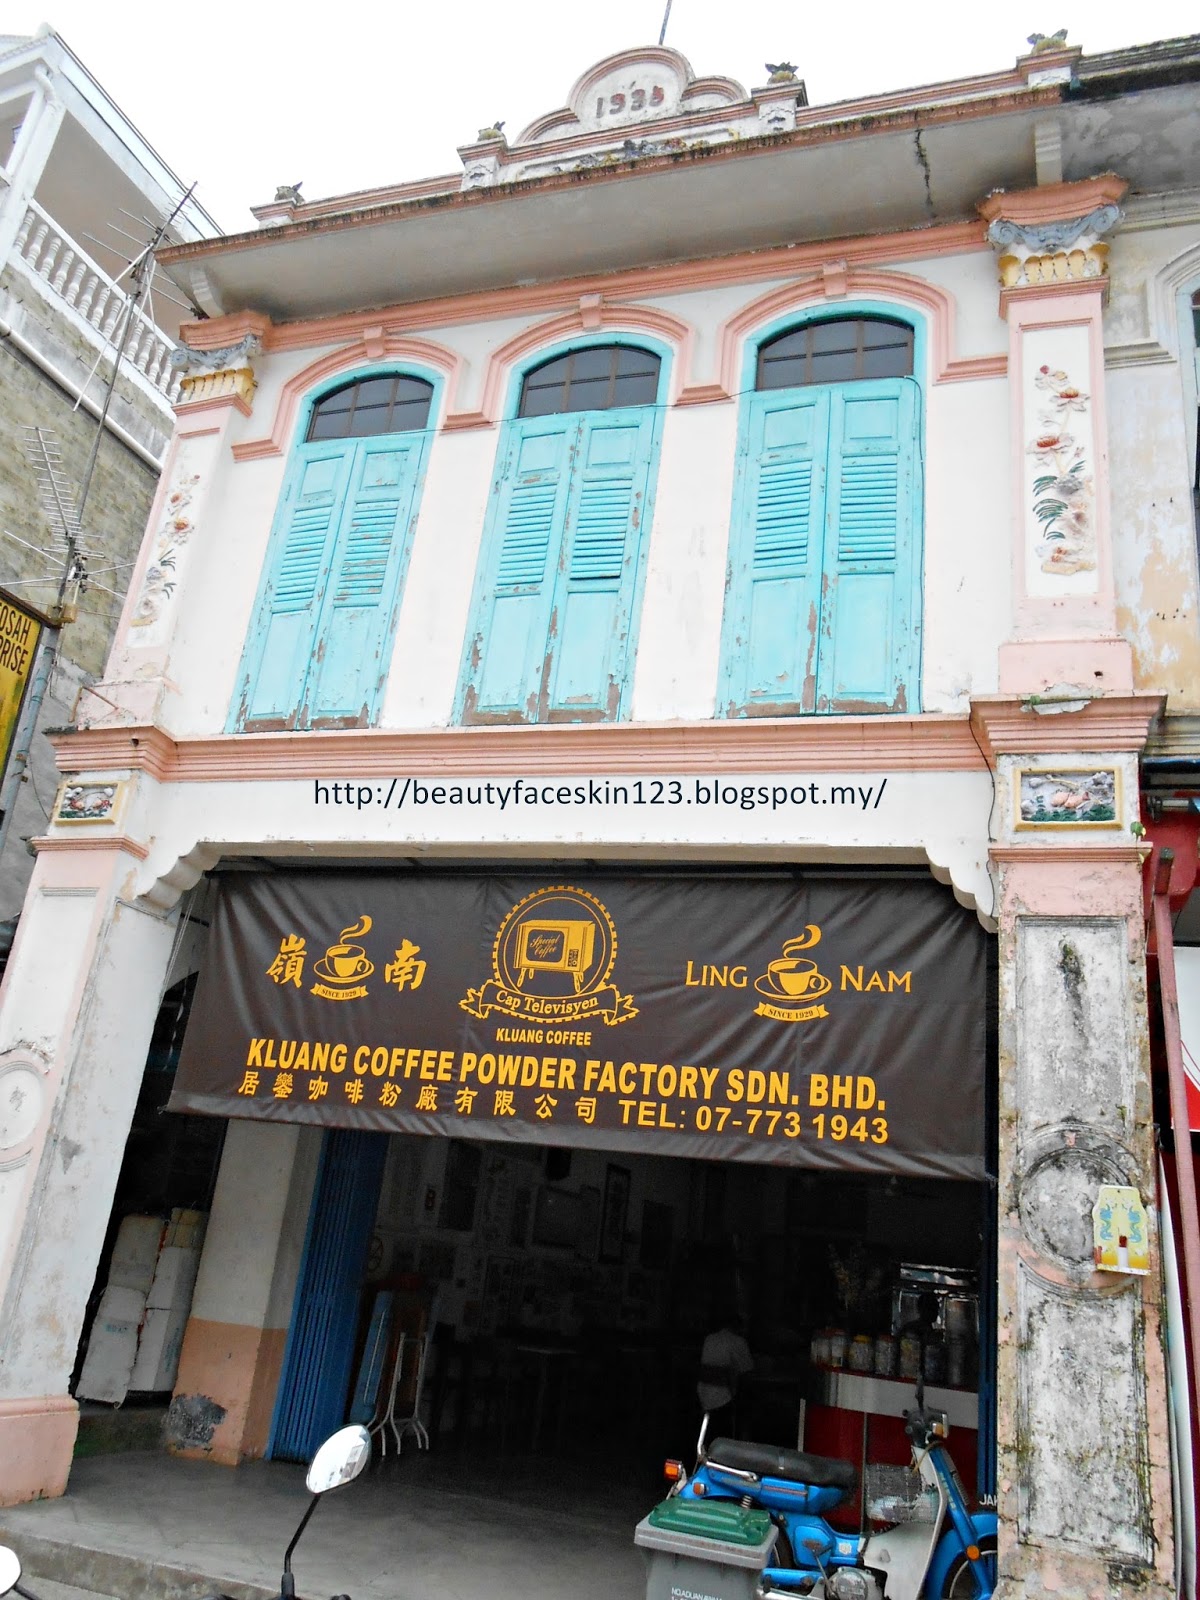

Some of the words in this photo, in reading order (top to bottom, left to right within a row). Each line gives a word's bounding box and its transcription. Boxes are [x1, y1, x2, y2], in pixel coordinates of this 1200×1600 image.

[0, 603, 32, 646] OSAH
[530, 934, 561, 948] Special
[534, 944, 558, 959] Coffee
[320, 988, 340, 999] SINCE
[342, 990, 358, 999] 1929
[496, 990, 521, 1011] Cap
[524, 996, 599, 1016] Televisyen
[768, 1008, 793, 1020] SINCE
[795, 1009, 814, 1020] 1929
[496, 1028, 544, 1044] KLUANG
[545, 1031, 592, 1046] COFFEE
[246, 1038, 348, 1072] KLUANG
[353, 1045, 455, 1082] COFFEE
[459, 1052, 577, 1090] POWDER
[583, 1059, 720, 1100] FACTORY
[726, 1068, 799, 1105] SDN.
[809, 1073, 886, 1111] BHD.
[618, 1099, 686, 1129] TEL:
[695, 1105, 801, 1138] 07-773
[812, 1113, 889, 1144] 1943
